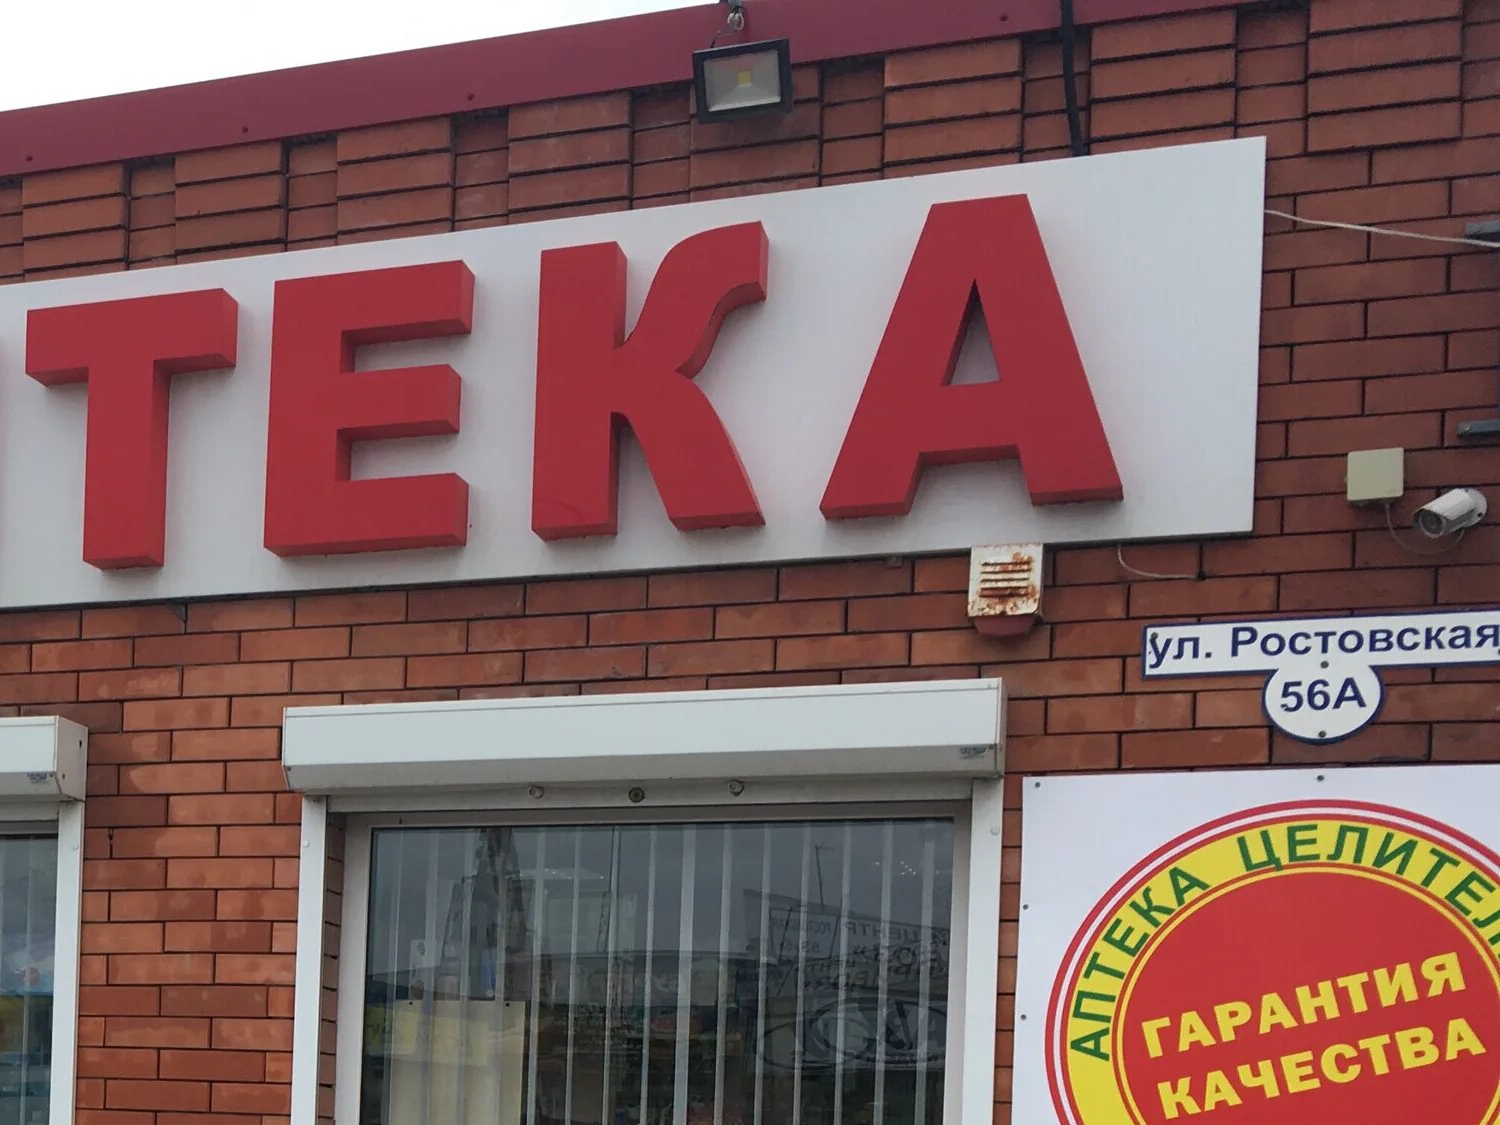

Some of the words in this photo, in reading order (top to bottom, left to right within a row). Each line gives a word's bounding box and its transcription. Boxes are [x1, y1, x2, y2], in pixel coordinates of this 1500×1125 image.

[1148, 634, 1212, 669] ул.
[1231, 622, 1500, 658] Ростовская
[1280, 676, 1367, 713] 56А
[1069, 866, 1212, 1062] АПТЕКА
[1142, 952, 1467, 1059] ГАРАНТИЯ
[1157, 1017, 1487, 1120] КАЧЕСТВА
